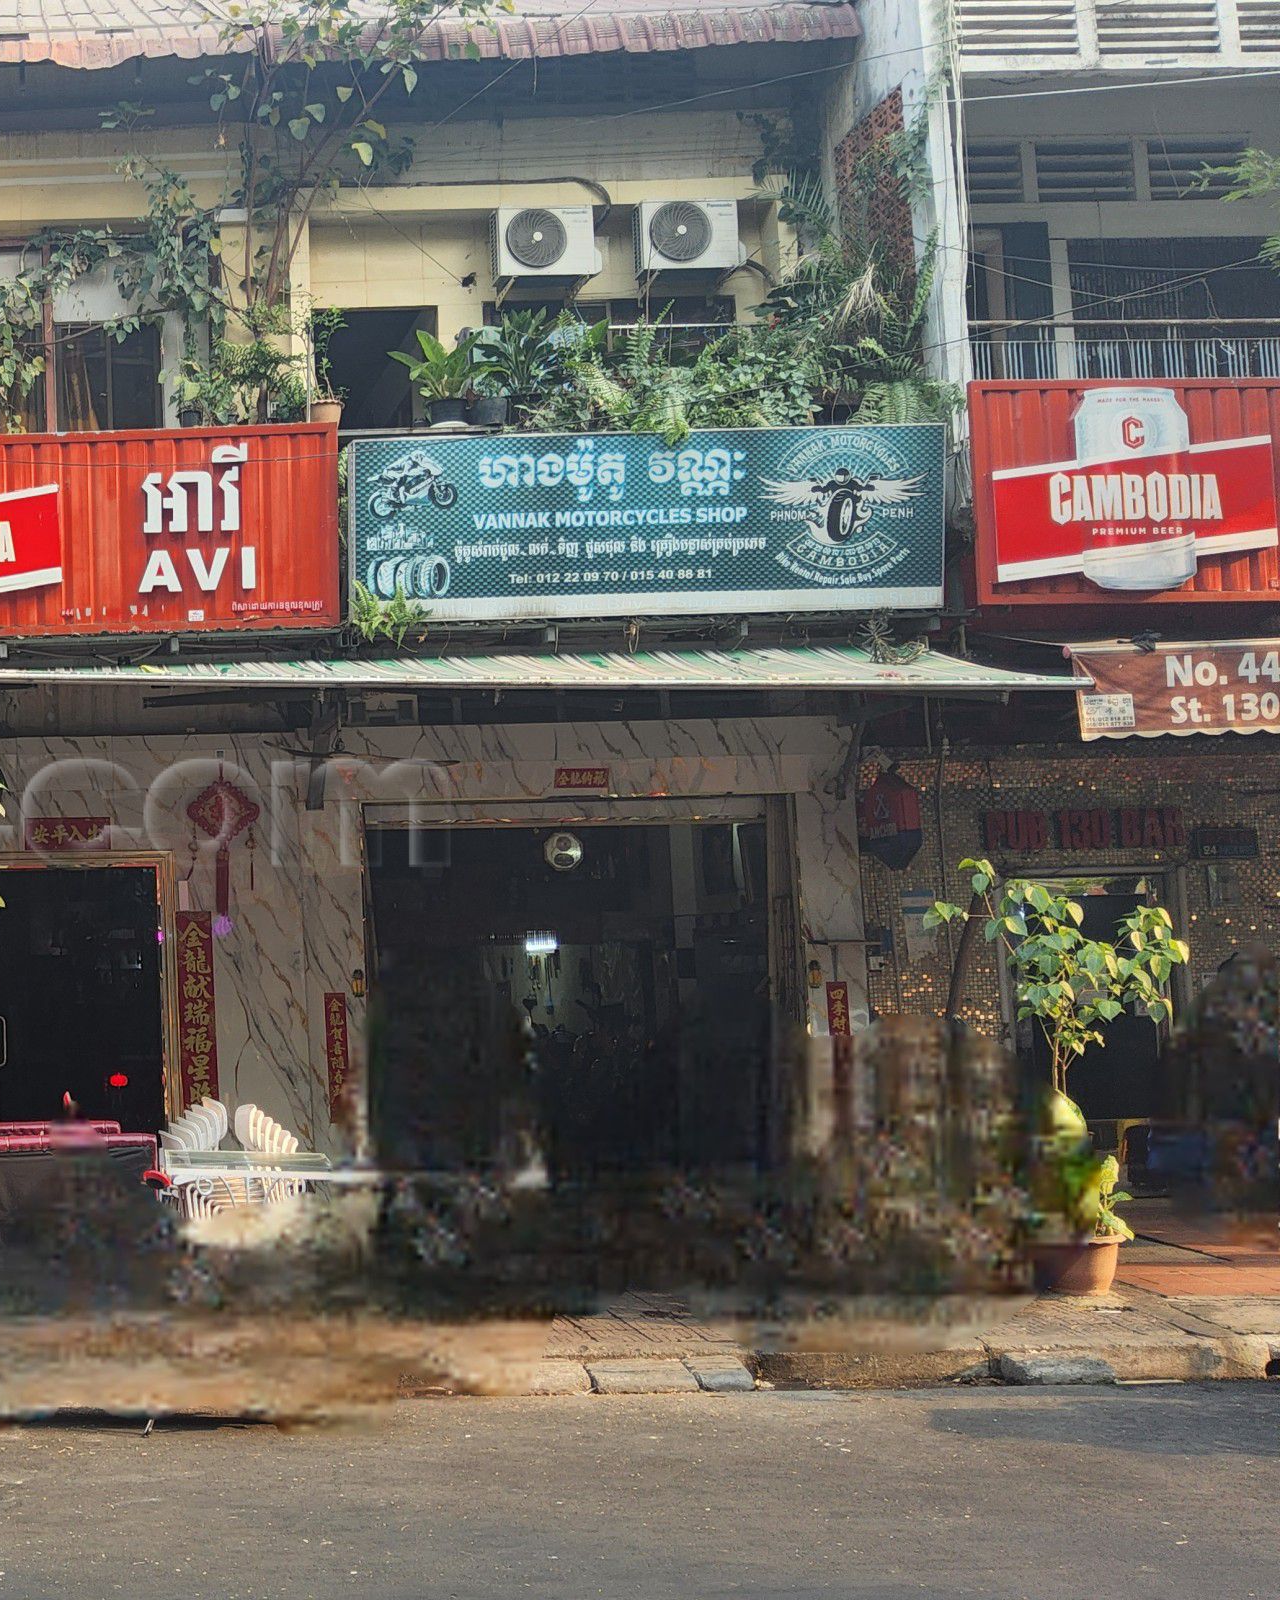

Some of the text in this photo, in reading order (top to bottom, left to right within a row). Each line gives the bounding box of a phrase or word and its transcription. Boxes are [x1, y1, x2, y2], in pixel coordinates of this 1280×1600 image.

[1049, 471, 1224, 526] CAMBODIA
[473, 507, 748, 530] VANNAK MOTORCYCLES SHOP
[770, 507, 915, 522] PHNOM PENH
[1091, 526, 1183, 536] PREMIUM BEER
[796, 543, 890, 567] CAMBODIA
[139, 546, 257, 594] AVI
[508, 573, 533, 585] Tel:
[536, 572, 561, 584] 012
[563, 572, 580, 583] 22
[583, 571, 599, 582] 09
[602, 571, 619, 582] 70
[630, 570, 655, 581] 015
[658, 569, 674, 580] 40
[697, 568, 713, 579] 81
[1166, 655, 1228, 688] No.
[1170, 696, 1212, 724] St.
